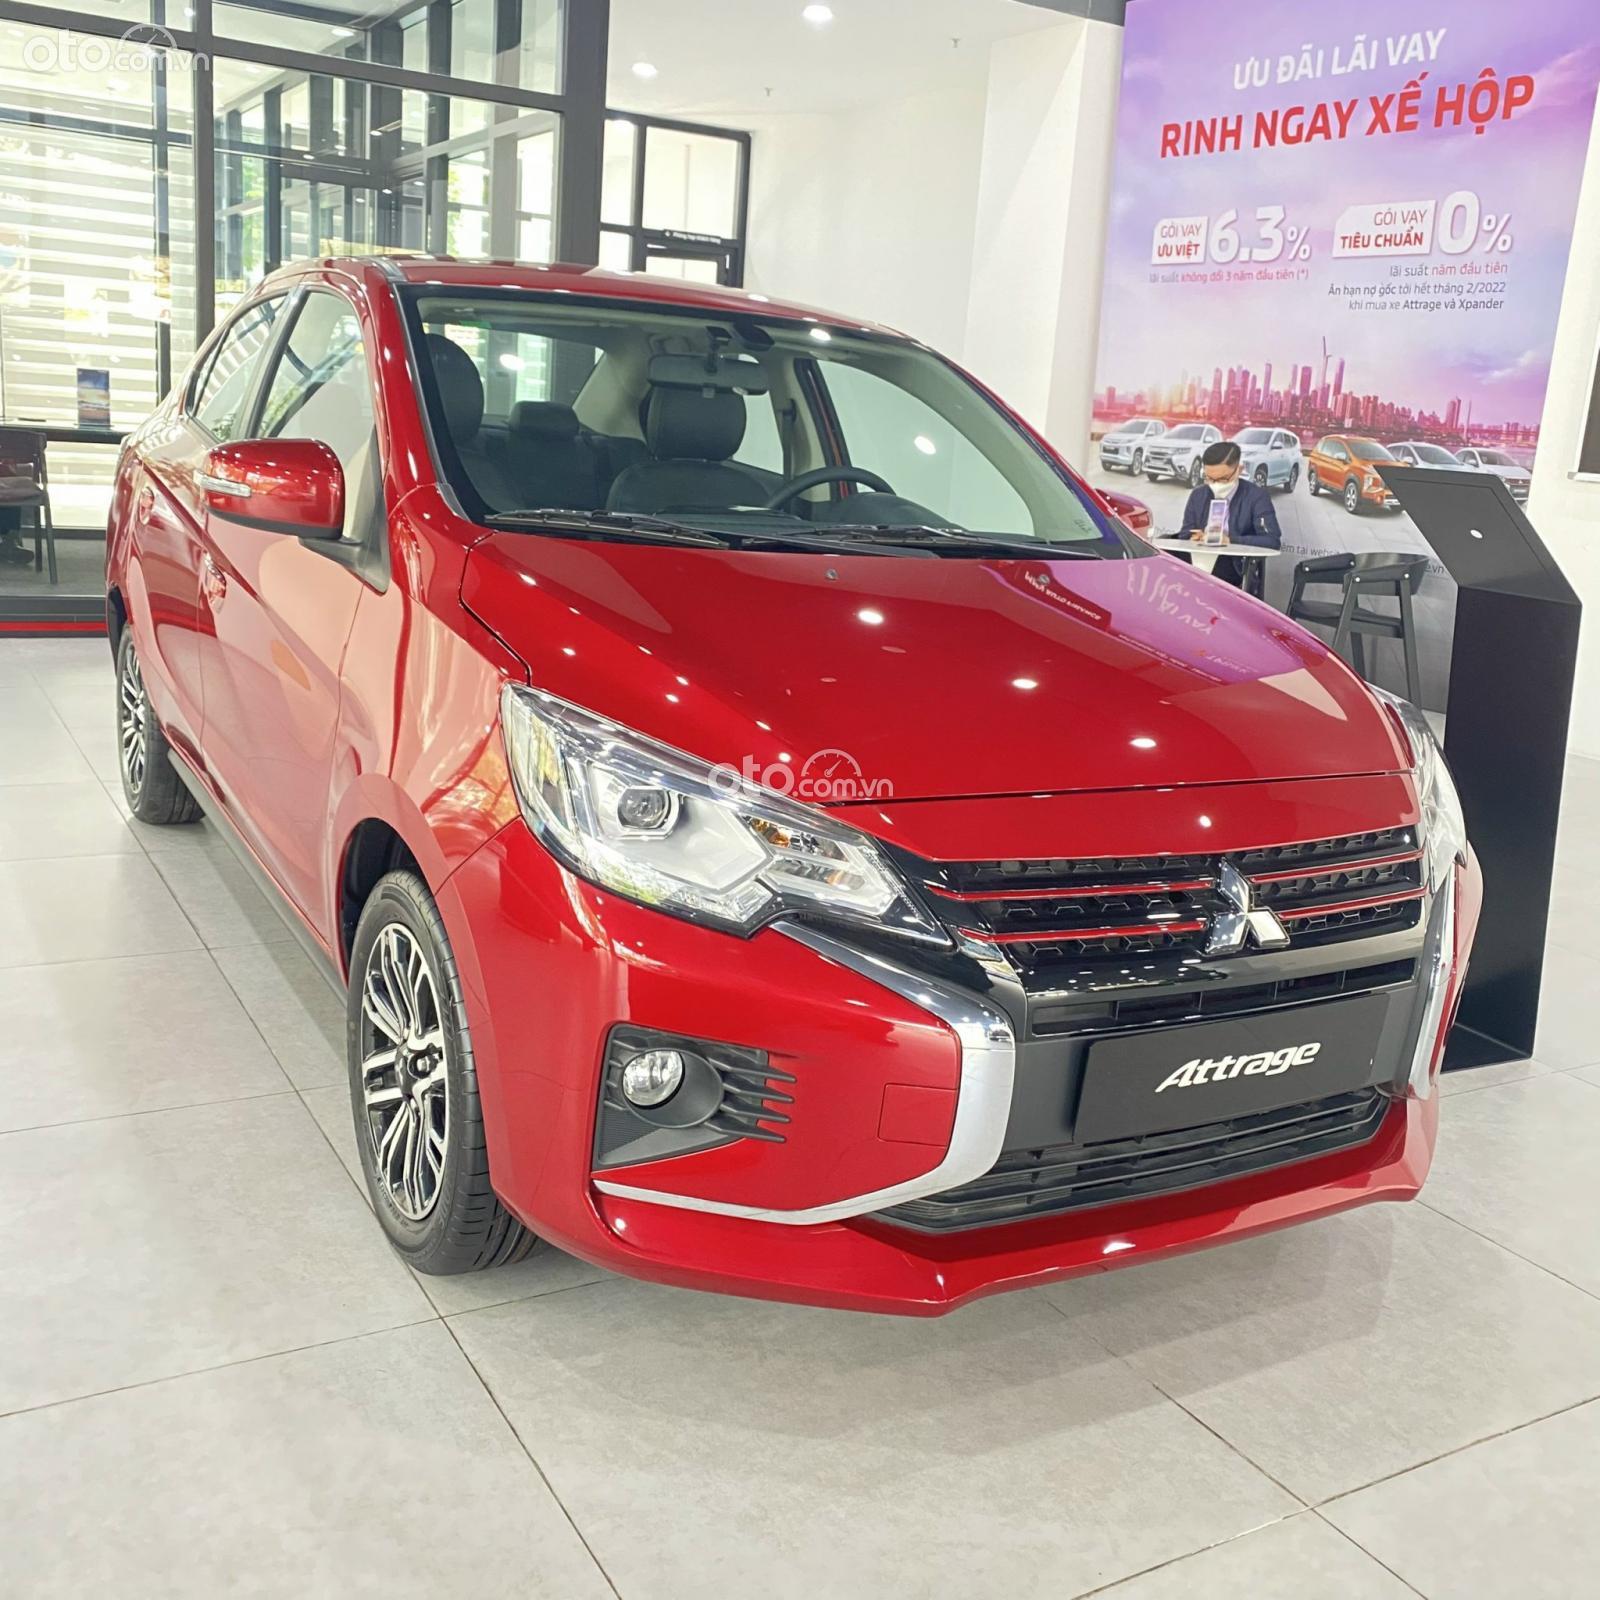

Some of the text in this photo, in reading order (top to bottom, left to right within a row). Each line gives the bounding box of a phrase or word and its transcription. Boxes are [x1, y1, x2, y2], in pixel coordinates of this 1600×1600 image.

[1233, 28, 1447, 90] ƯU ĐÃI LÃI VAY
[1160, 68, 1535, 158] RINH NGAY XẾ HỘP
[1374, 207, 1428, 226] GÓI VAY
[1181, 223, 1202, 237] VAY
[1340, 226, 1424, 249] TIÊU CHUẨN
[1175, 240, 1200, 259] VIỆT
[1226, 271, 1232, 282] 3
[1404, 262, 1429, 277] suất
[1431, 264, 1456, 276] năm
[1485, 261, 1508, 274] tiên
[1343, 285, 1361, 298] hạn
[1413, 281, 1431, 295] hết
[1433, 282, 1464, 297] tháng
[1466, 281, 1506, 294] 2/2022
[1349, 298, 1504, 313] khi mua xe Attrage và Xpander
[1155, 1042, 1321, 1093] Attrage
